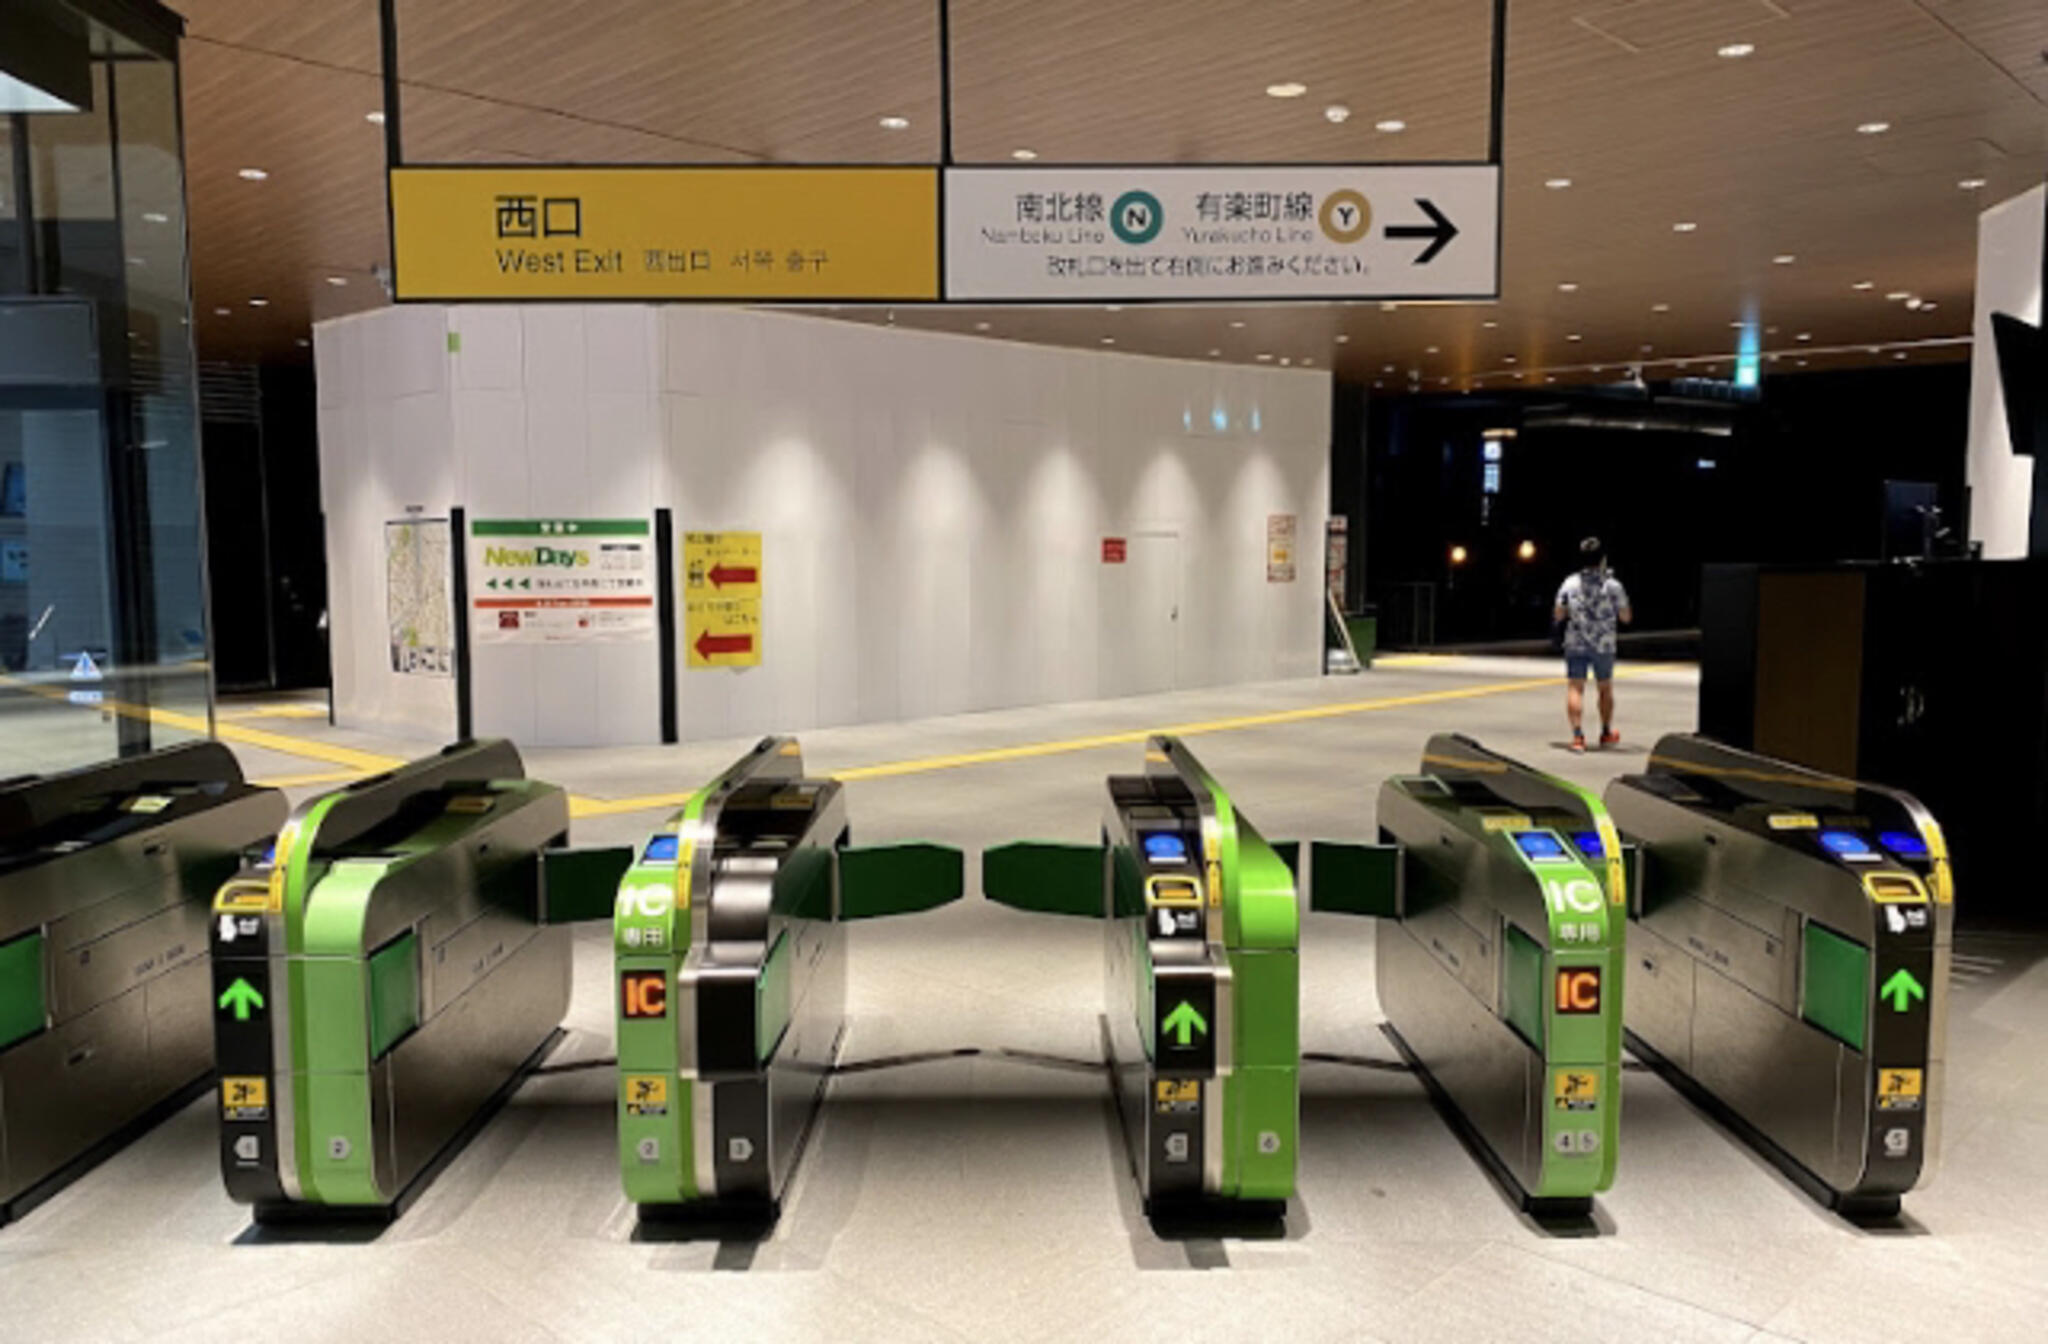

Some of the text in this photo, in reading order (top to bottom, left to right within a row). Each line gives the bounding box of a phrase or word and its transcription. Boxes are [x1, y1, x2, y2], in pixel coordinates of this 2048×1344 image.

[495, 195, 581, 238] 西口
[1014, 191, 1105, 222] 南北線
[1127, 207, 1147, 228] N
[1196, 191, 1313, 222] 有楽町線
[1337, 207, 1354, 226] Y
[1276, 226, 1313, 244] Line
[496, 249, 622, 273] West Exit
[485, 546, 590, 567] NewDays
[618, 884, 673, 917] IC
[1548, 879, 1601, 914] IC
[626, 977, 666, 1015] IC
[1557, 973, 1599, 1010] IC
